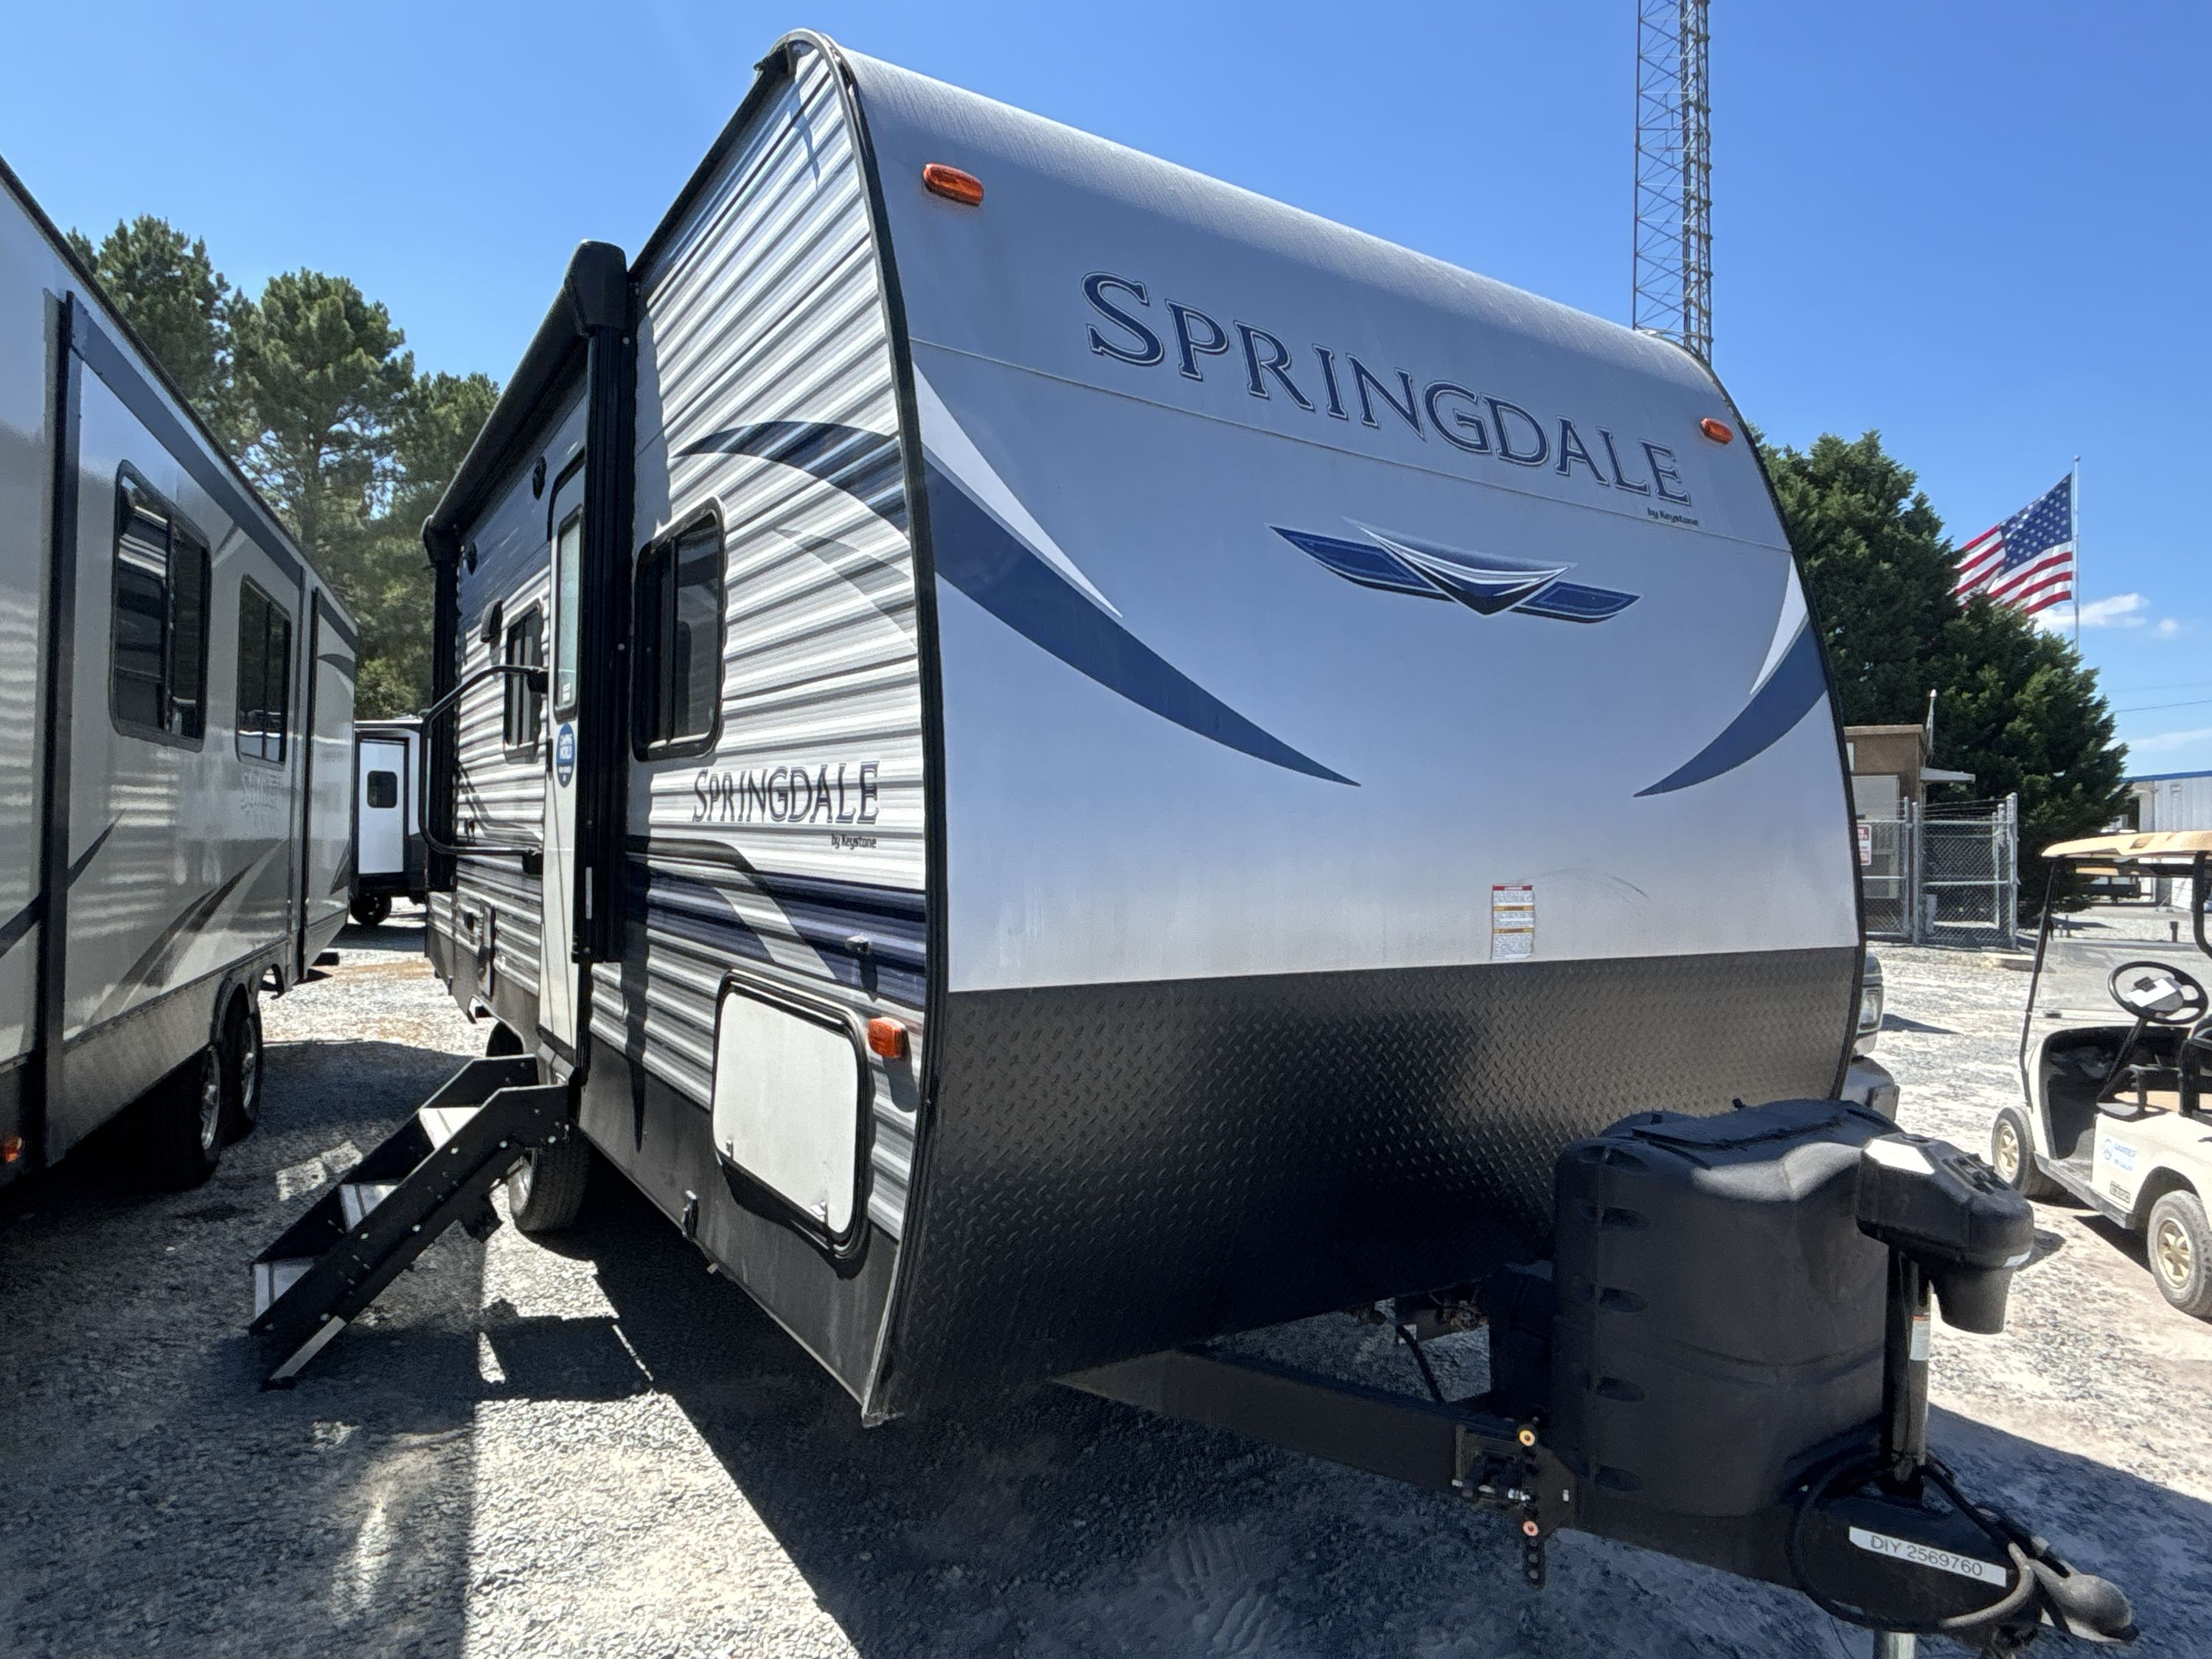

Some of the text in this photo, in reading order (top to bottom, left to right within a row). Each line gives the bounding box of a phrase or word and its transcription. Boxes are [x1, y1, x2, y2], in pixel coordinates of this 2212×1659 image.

[1081, 271, 1692, 507] SPRINGDALE
[1646, 507, 1700, 527] by Keystone
[692, 760, 880, 824] SPRINGDALE
[831, 832, 877, 850] by Keystone
[1869, 1534, 1983, 1577] DIY 2569760
